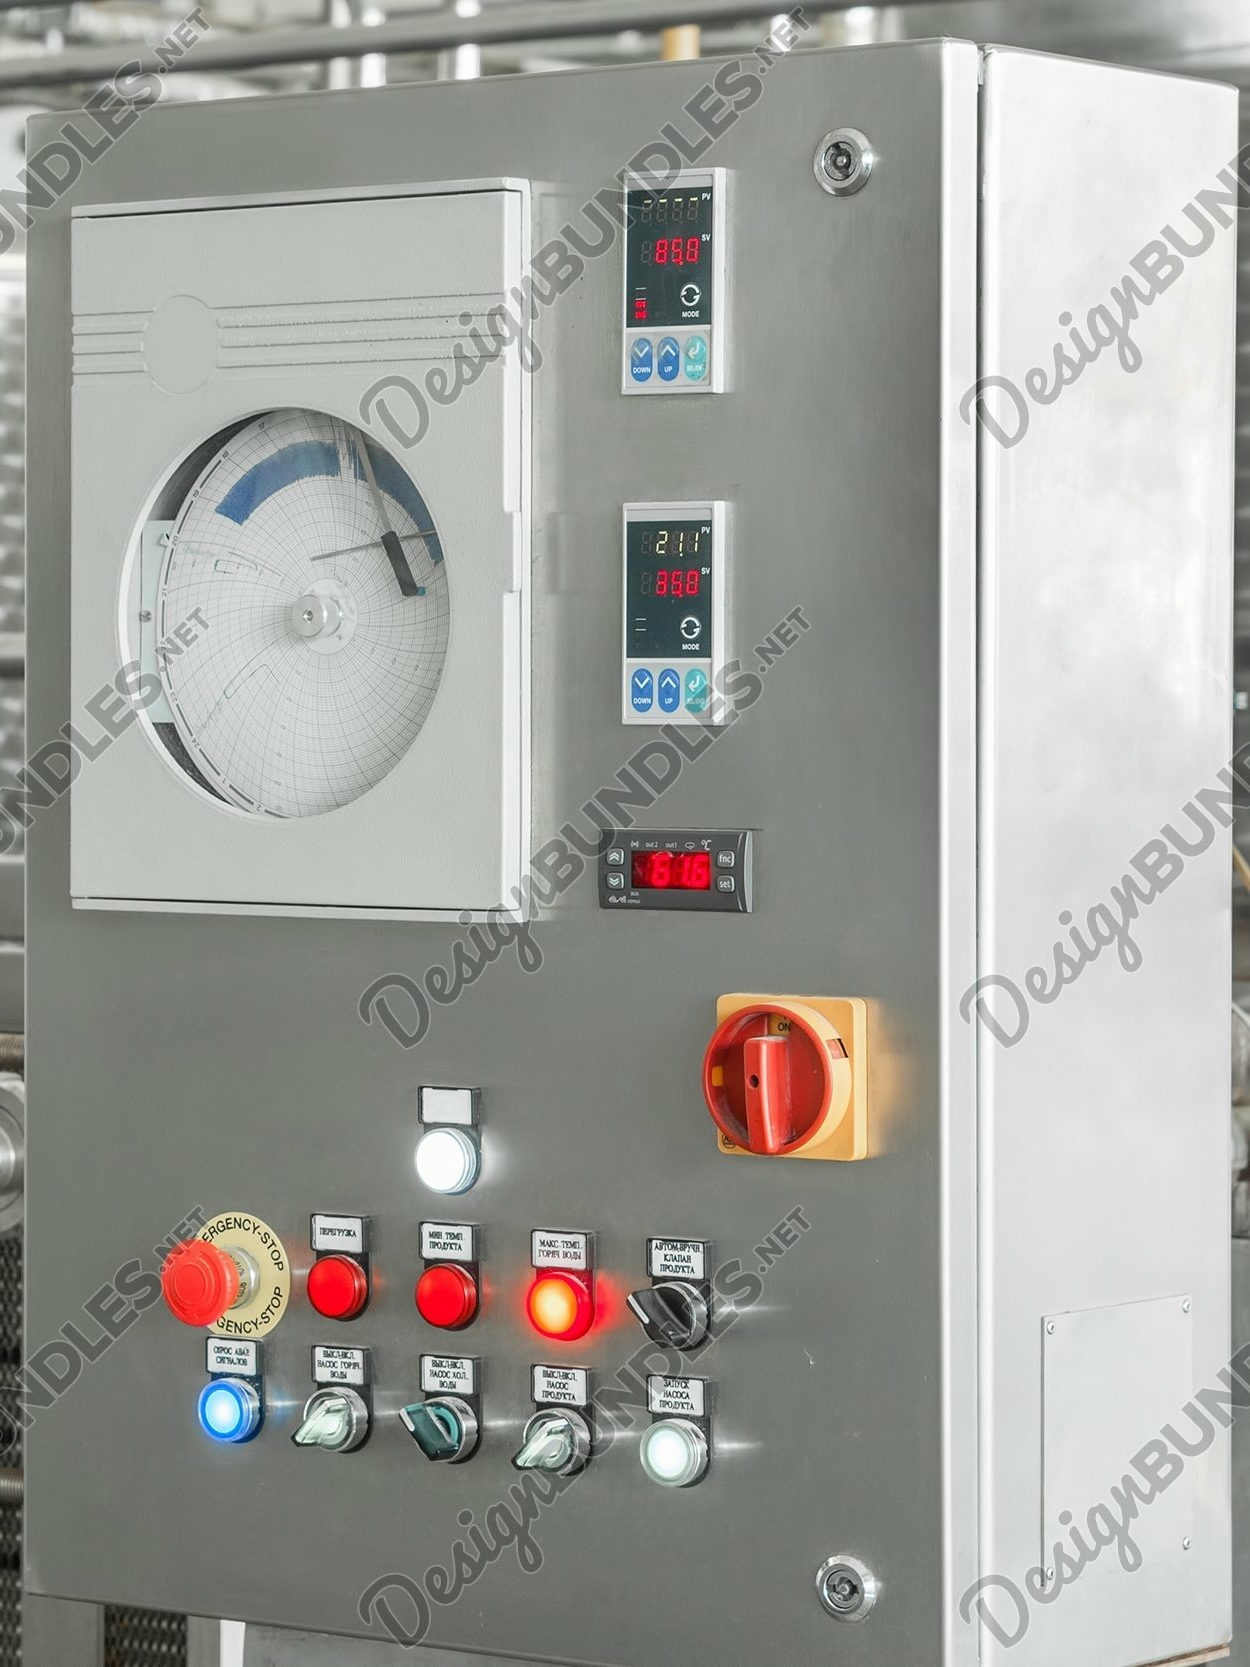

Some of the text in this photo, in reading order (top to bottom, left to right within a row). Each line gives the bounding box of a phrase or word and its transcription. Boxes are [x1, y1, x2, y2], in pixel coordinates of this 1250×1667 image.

[701, 193, 711, 201] PV
[701, 233, 711, 242] SV
[633, 366, 651, 374] DOWN
[664, 365, 673, 373] UP
[192, 489, 200, 498] 19
[701, 526, 711, 534] PV
[656, 531, 699, 557] 21.1
[701, 567, 711, 575] SV
[633, 697, 651, 705] DOWN
[718, 854, 731, 864] fnc
[719, 879, 731, 888] set
[777, 1022, 791, 1032] ON
[319, 1227, 357, 1238] ПЕРЕГРУЗКА
[201, 1217, 284, 1271] ERGENCY-STOP
[429, 1241, 462, 1251] ПРОДУКТА
[561, 1240, 583, 1249] ТЕМП.
[562, 1251, 582, 1260] ВОДЫ
[663, 1254, 692, 1263] КЛАПАН
[659, 1264, 695, 1274] ПРОДУКТА
[216, 1286, 284, 1334] GENCY-STOP
[216, 1355, 248, 1366] СИГНАЛОВ
[317, 1359, 338, 1369] НАСОС
[330, 1370, 347, 1380] ВОДЫ
[429, 1369, 469, 1380] НАСОС ХОЛ.
[439, 1380, 456, 1390] ВОДЫ
[546, 1380, 569, 1390] НАСОС
[663, 1379, 690, 1389] ЗАПУСК
[542, 1390, 576, 1401] ПРОДУКТА
[663, 1390, 690, 1400] НАСОСА
[659, 1400, 695, 1411] ПРОДУКТА
